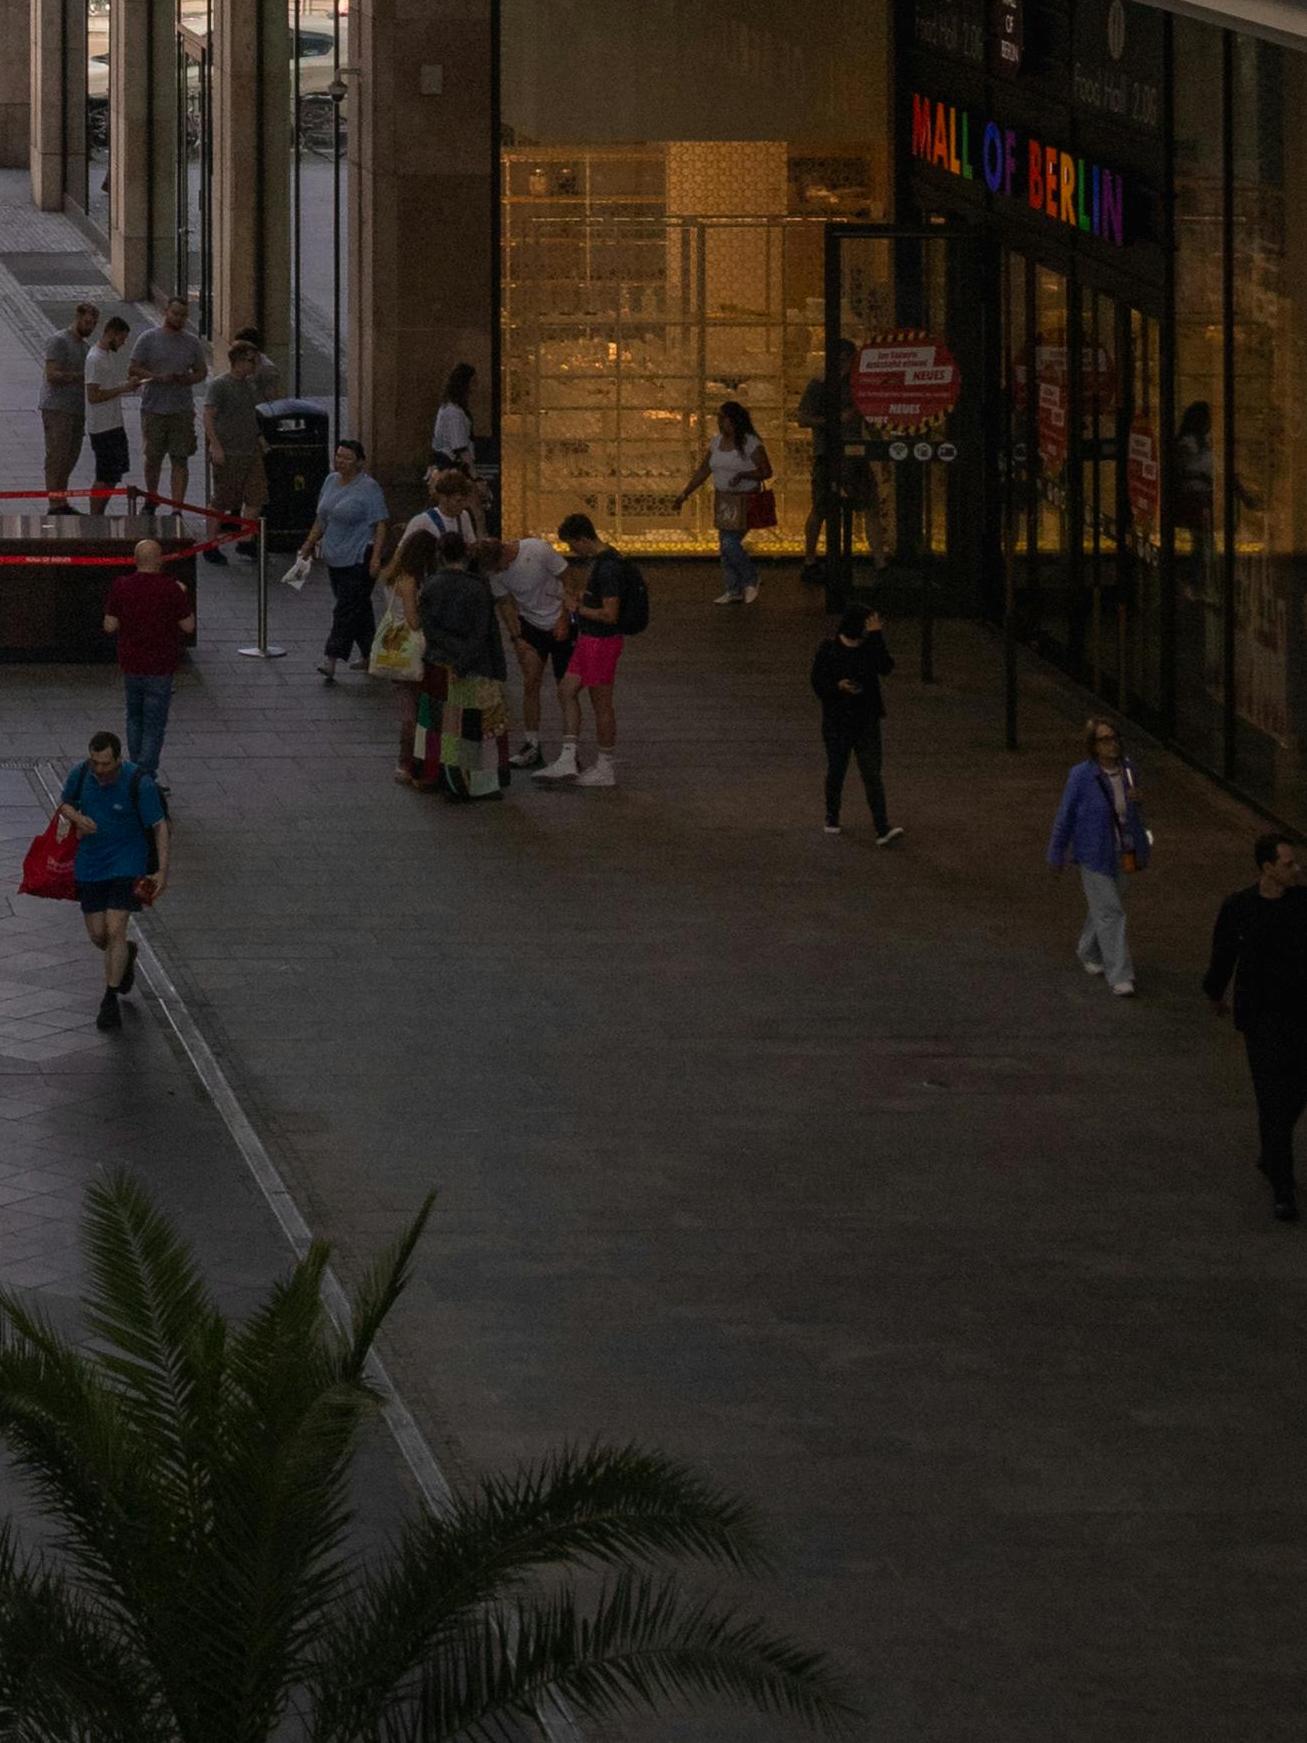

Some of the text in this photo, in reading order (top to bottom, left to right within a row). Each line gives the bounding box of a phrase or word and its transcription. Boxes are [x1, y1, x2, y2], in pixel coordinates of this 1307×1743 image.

[909, 91, 1126, 246] MALL OF BERLIN
[912, 371, 946, 381] NEUES
